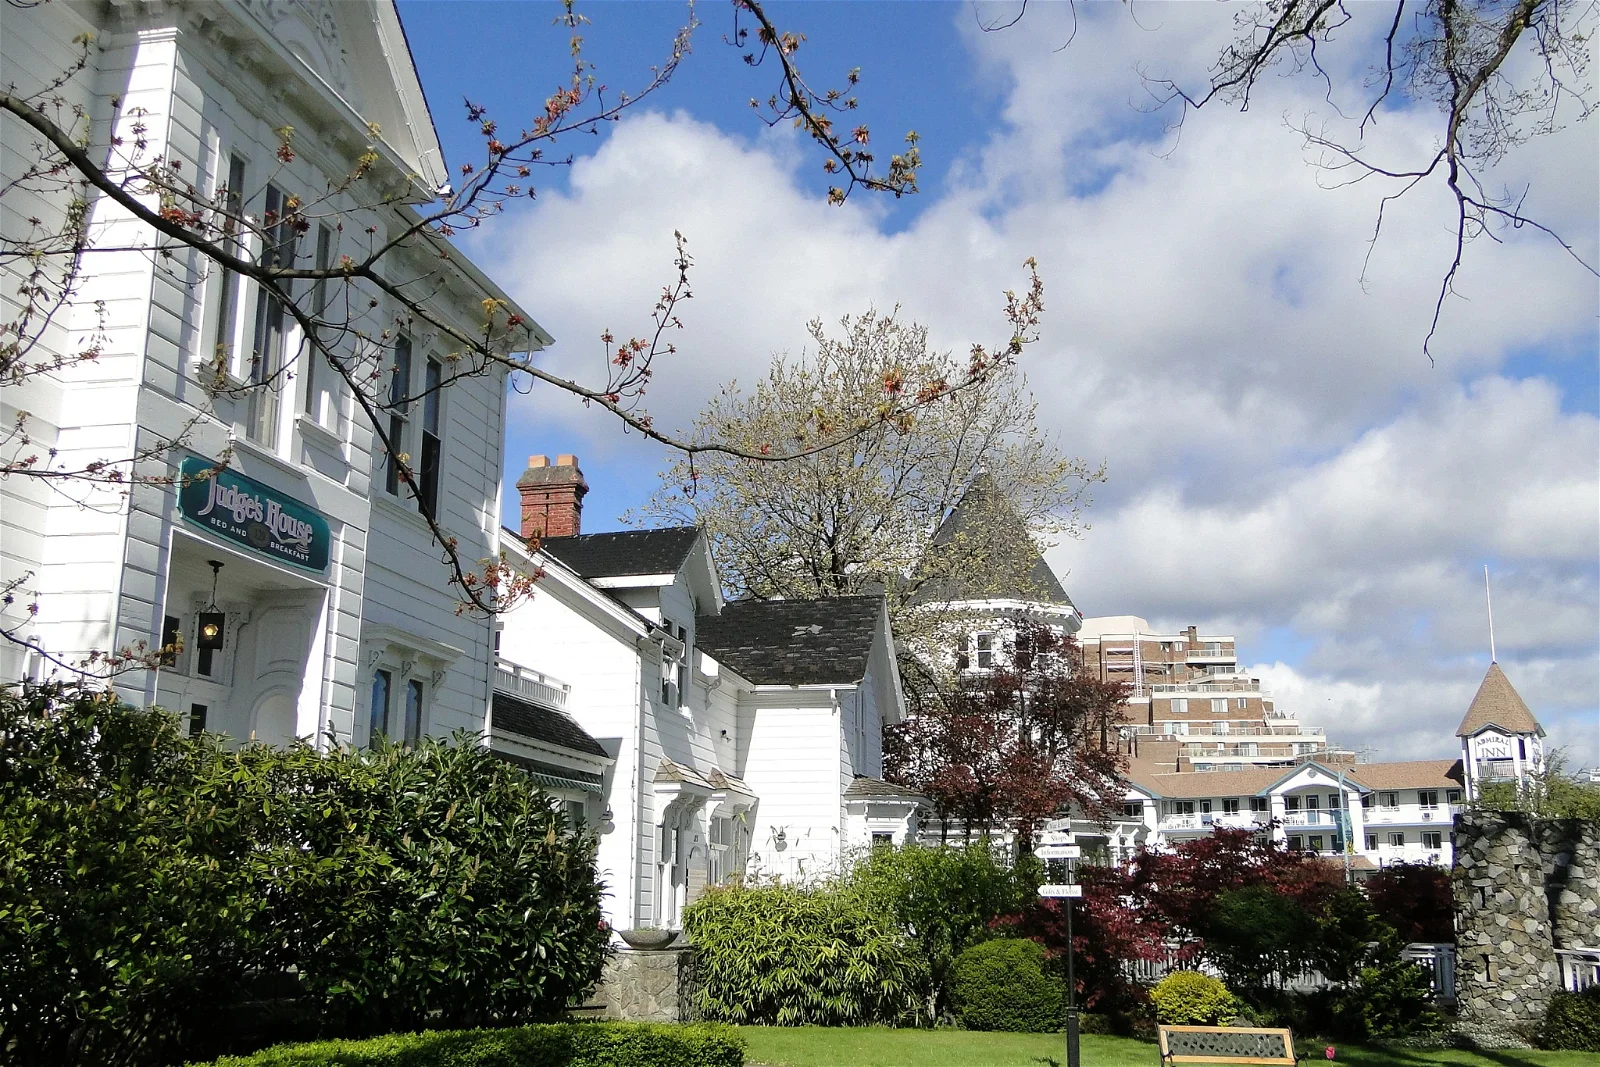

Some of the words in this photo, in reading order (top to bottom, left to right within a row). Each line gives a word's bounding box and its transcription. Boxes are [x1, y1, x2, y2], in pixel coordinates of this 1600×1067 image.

[198, 474, 264, 523] Judge's
[265, 498, 313, 545] House
[210, 518, 228, 530] BED
[230, 525, 247, 537] AND
[270, 541, 310, 561] BREAKFAST
[1476, 736, 1509, 746] ADMIRAL
[1481, 747, 1506, 758] INN
[1041, 848, 1074, 856] Information
